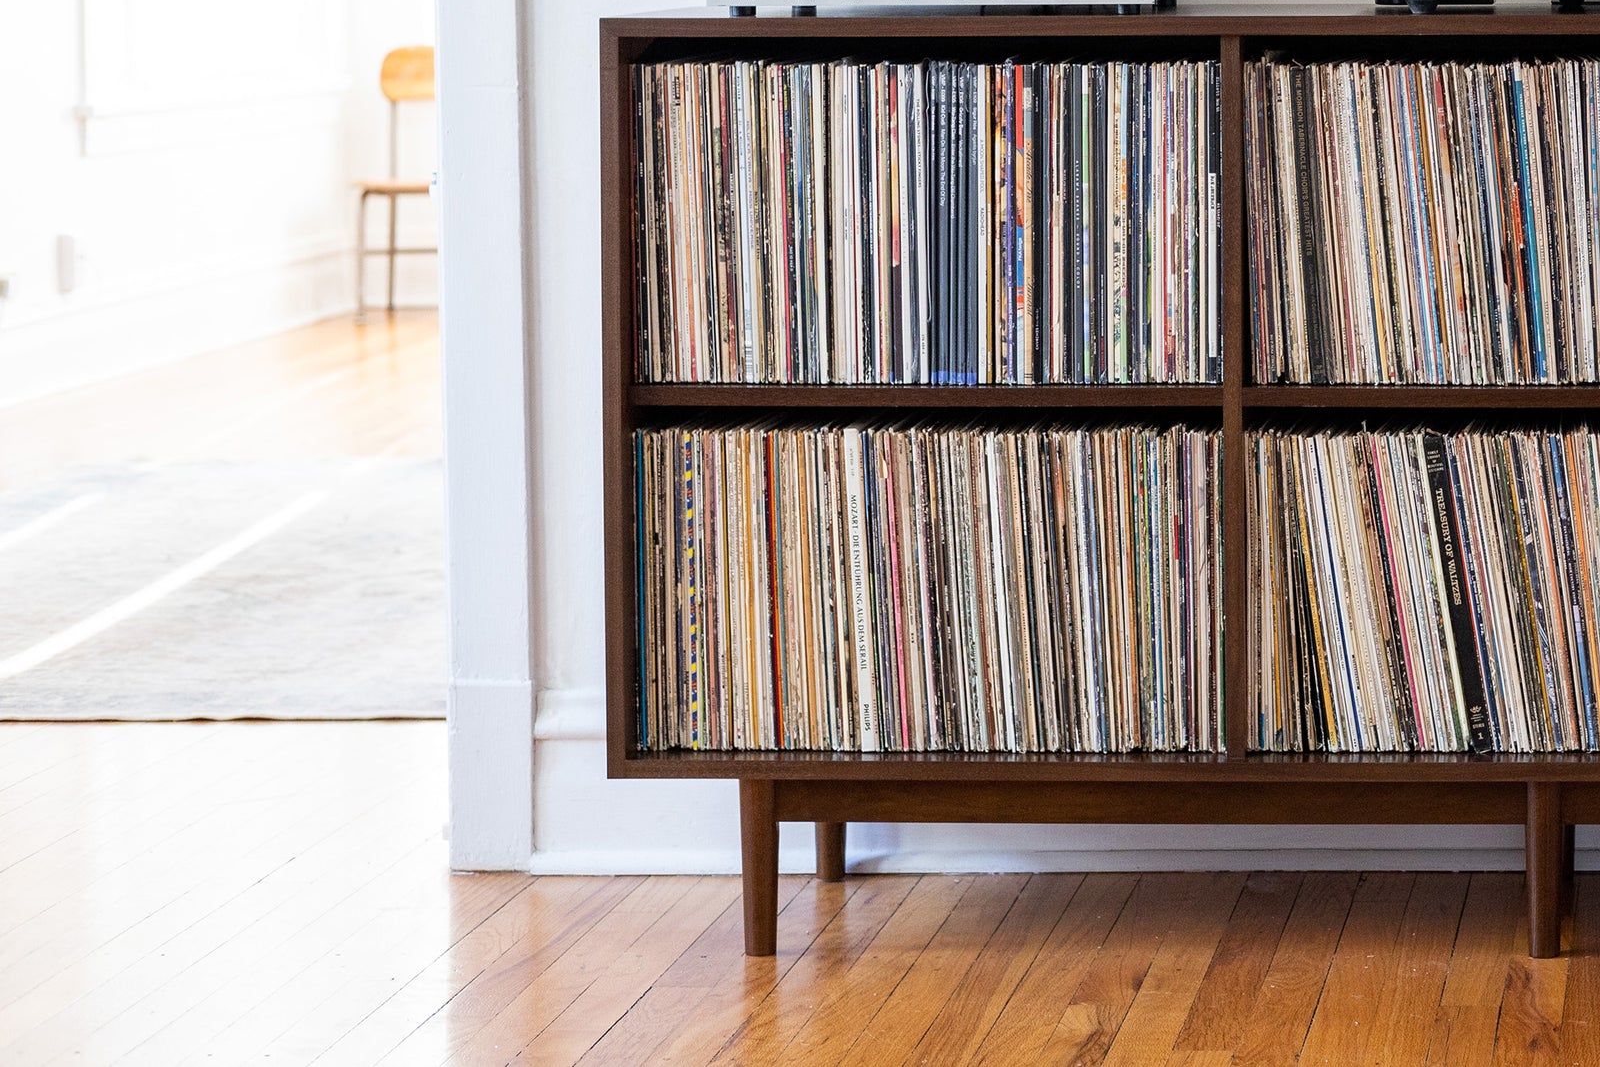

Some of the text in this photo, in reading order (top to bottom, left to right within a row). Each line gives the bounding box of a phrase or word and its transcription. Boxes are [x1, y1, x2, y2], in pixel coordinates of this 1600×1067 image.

[1296, 89, 1304, 122] MORMON
[1298, 123, 1307, 169] TABERNACLE
[1301, 171, 1309, 200] CHOIR'S
[1303, 201, 1311, 238] GREATEST
[1305, 239, 1313, 256] HITS
[1436, 488, 1462, 605] TREASURY OF WALTZES
[854, 549, 863, 605] ENTFÜHRUNG
